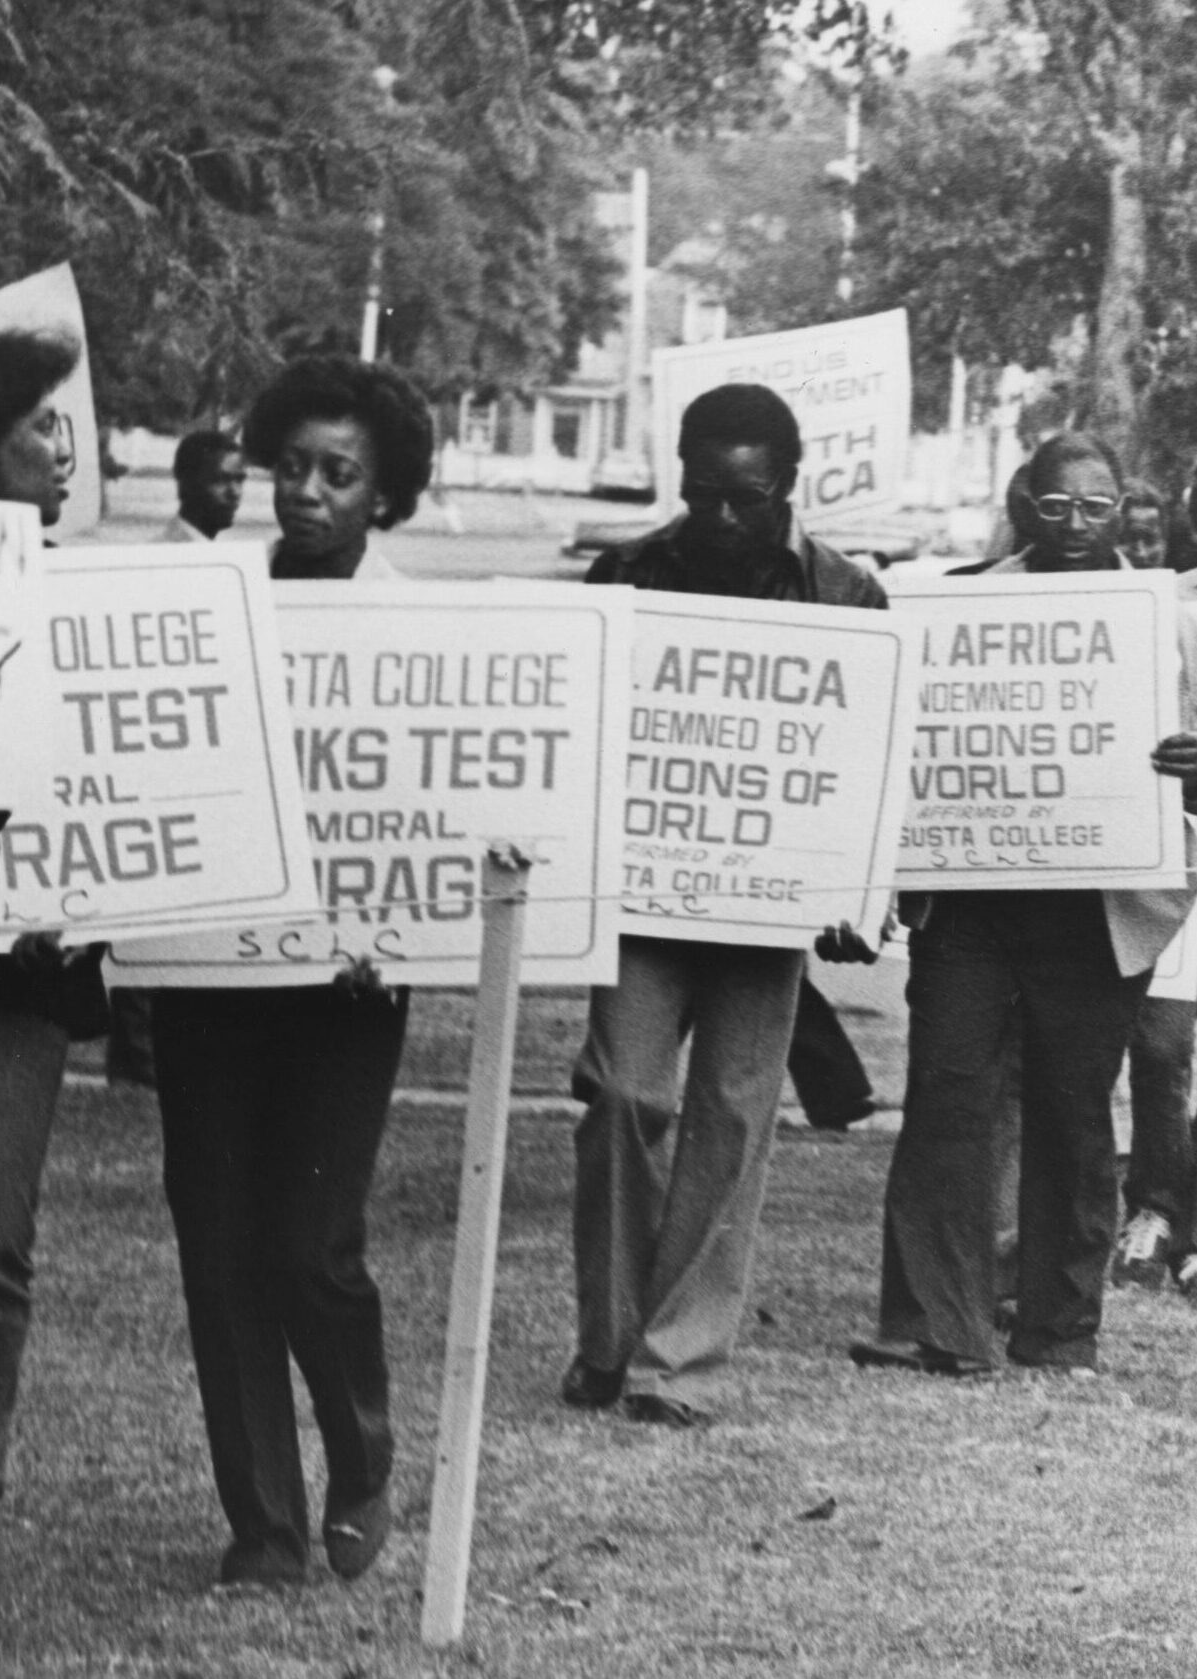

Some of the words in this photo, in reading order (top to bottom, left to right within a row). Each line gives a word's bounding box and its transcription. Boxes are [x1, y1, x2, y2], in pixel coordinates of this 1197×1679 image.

[803, 425, 876, 460] TH
[804, 460, 875, 509] ICA
[49, 610, 219, 672] OLLEGE
[949, 620, 1115, 667] AFRICA
[372, 652, 568, 708] COLLEGE
[653, 645, 847, 709] AFRICA
[1060, 679, 1099, 712] BY
[62, 684, 228, 755] TEST
[629, 706, 760, 751] DEMNED
[777, 721, 825, 756] BY
[913, 723, 1056, 759] TIONS
[1069, 722, 1115, 756] OF
[408, 728, 570, 790] TEST
[782, 768, 838, 807] OF
[307, 810, 466, 843] MORAL
[624, 798, 773, 848] ORLD
[917, 805, 1017, 820] AFFIRMED
[1028, 805, 1056, 820] BY
[989, 825, 1104, 848] COLLEGE
[313, 854, 475, 924] RAG
[622, 864, 655, 889] TA
[671, 869, 804, 904] COLLEGE
